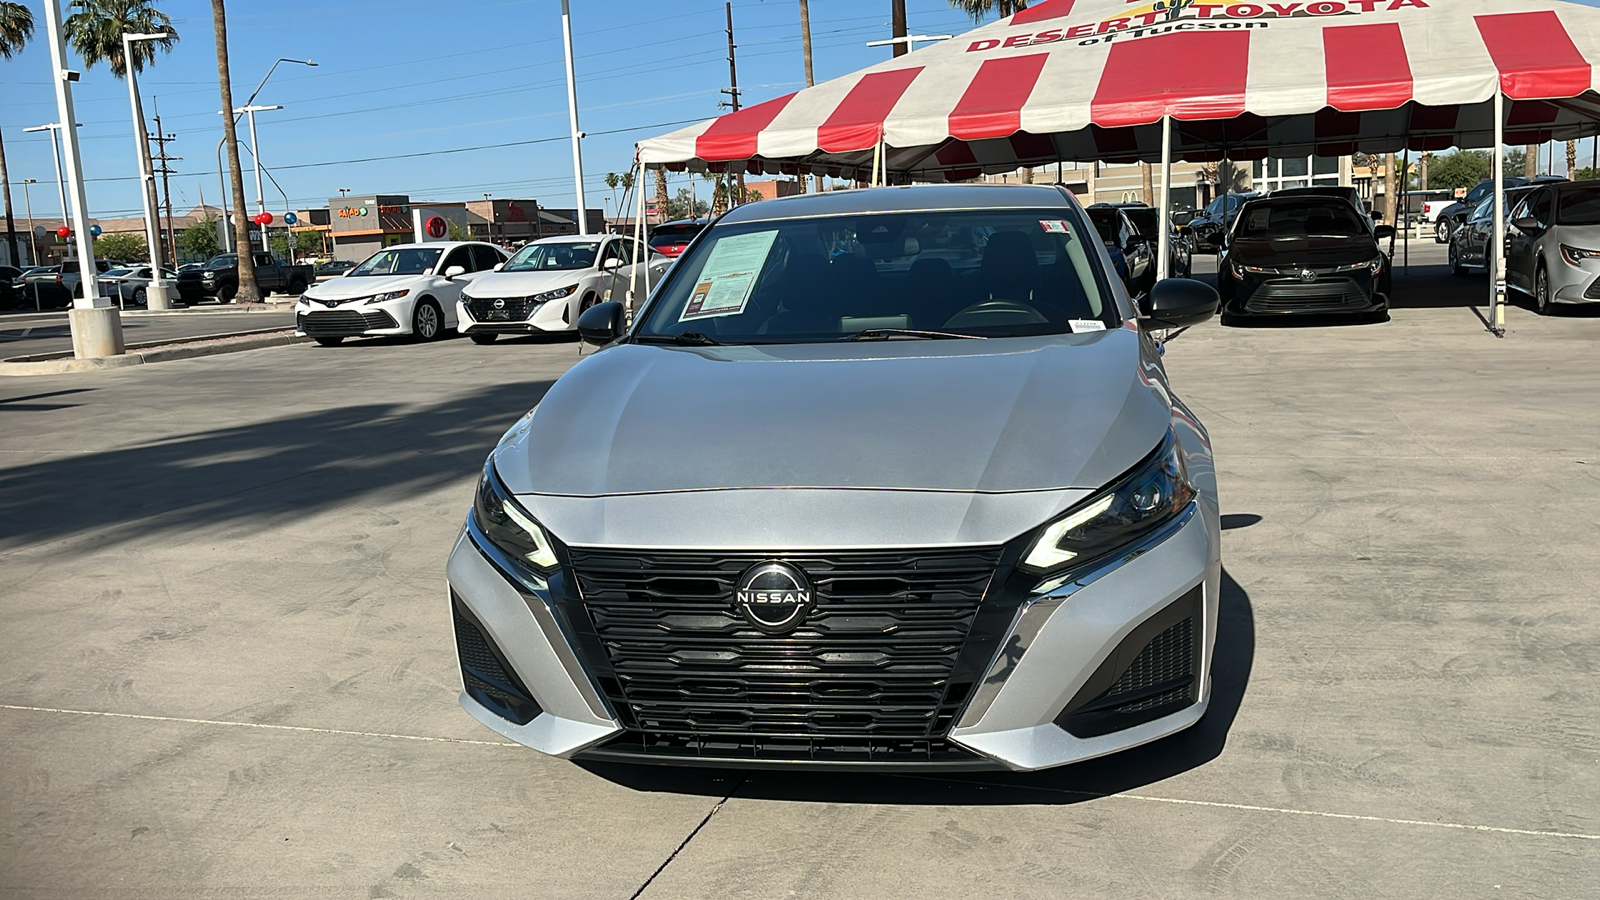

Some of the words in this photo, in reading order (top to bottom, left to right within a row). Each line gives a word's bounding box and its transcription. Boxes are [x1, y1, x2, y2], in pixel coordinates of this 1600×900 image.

[965, 9, 1168, 53] DESERT
[1188, 0, 1430, 18] TOYOTA
[1078, 30, 1118, 46] of
[1132, 21, 1268, 38] Tucson
[338, 207, 360, 218] SALAD
[738, 592, 809, 603] NISSAN
